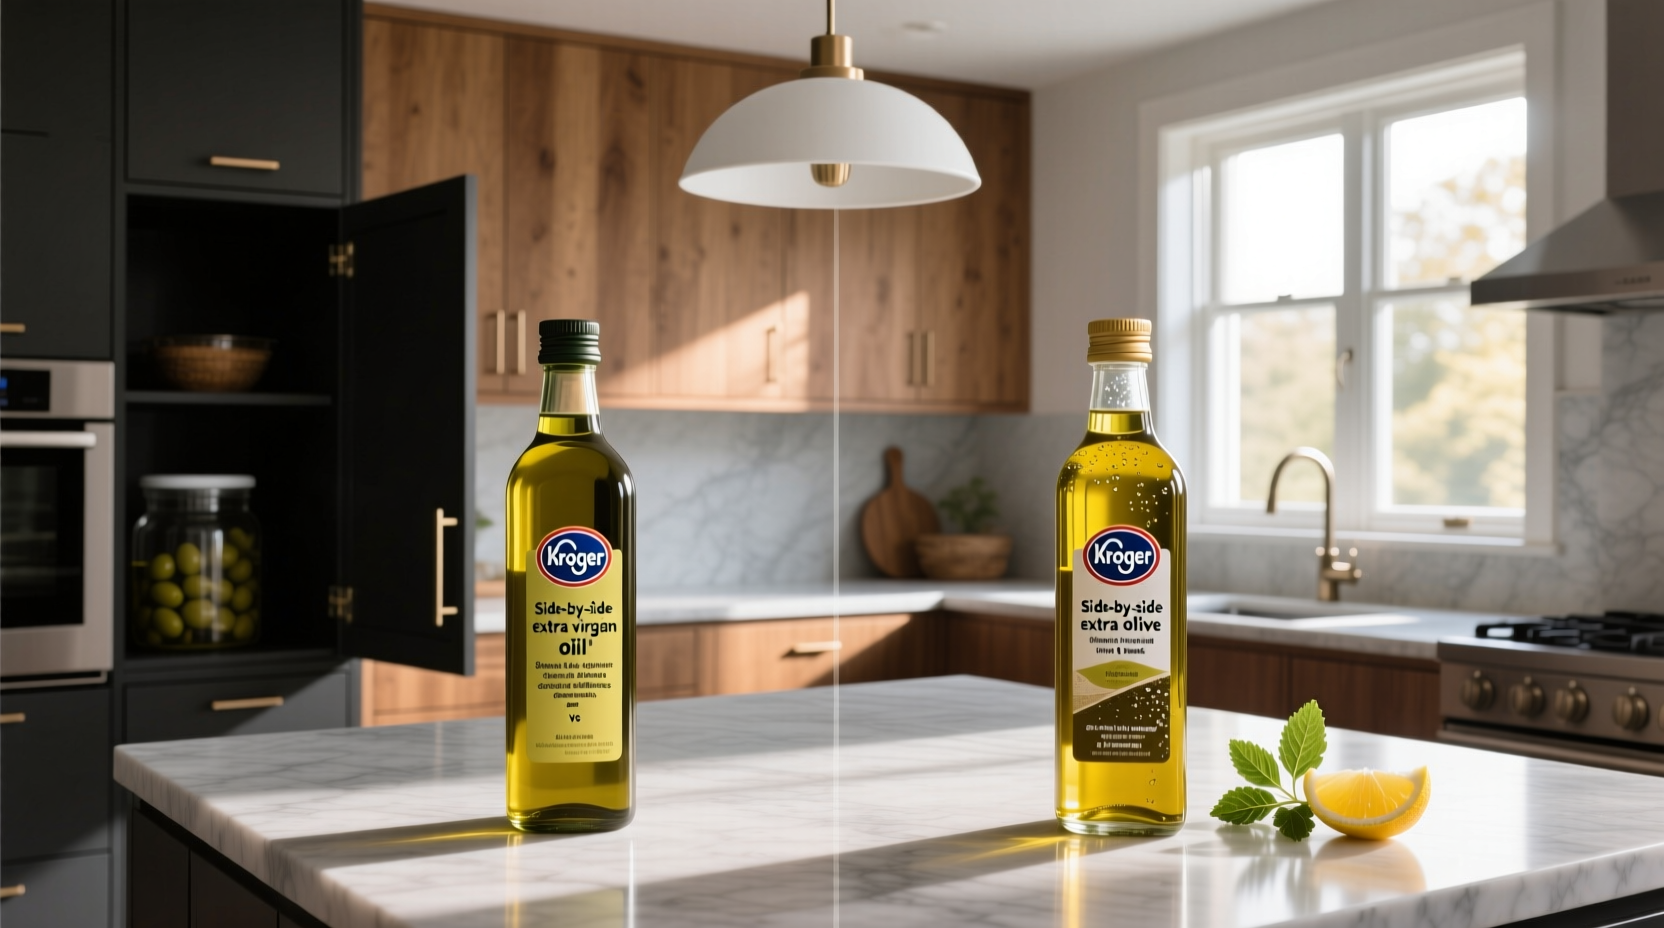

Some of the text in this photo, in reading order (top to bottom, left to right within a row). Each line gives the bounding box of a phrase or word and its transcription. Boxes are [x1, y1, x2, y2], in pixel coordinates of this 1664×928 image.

[547, 539, 605, 576] Kroger
[1094, 538, 1152, 575] Kroger
[532, 620, 568, 633] extra
[1081, 616, 1161, 631] extra olive
